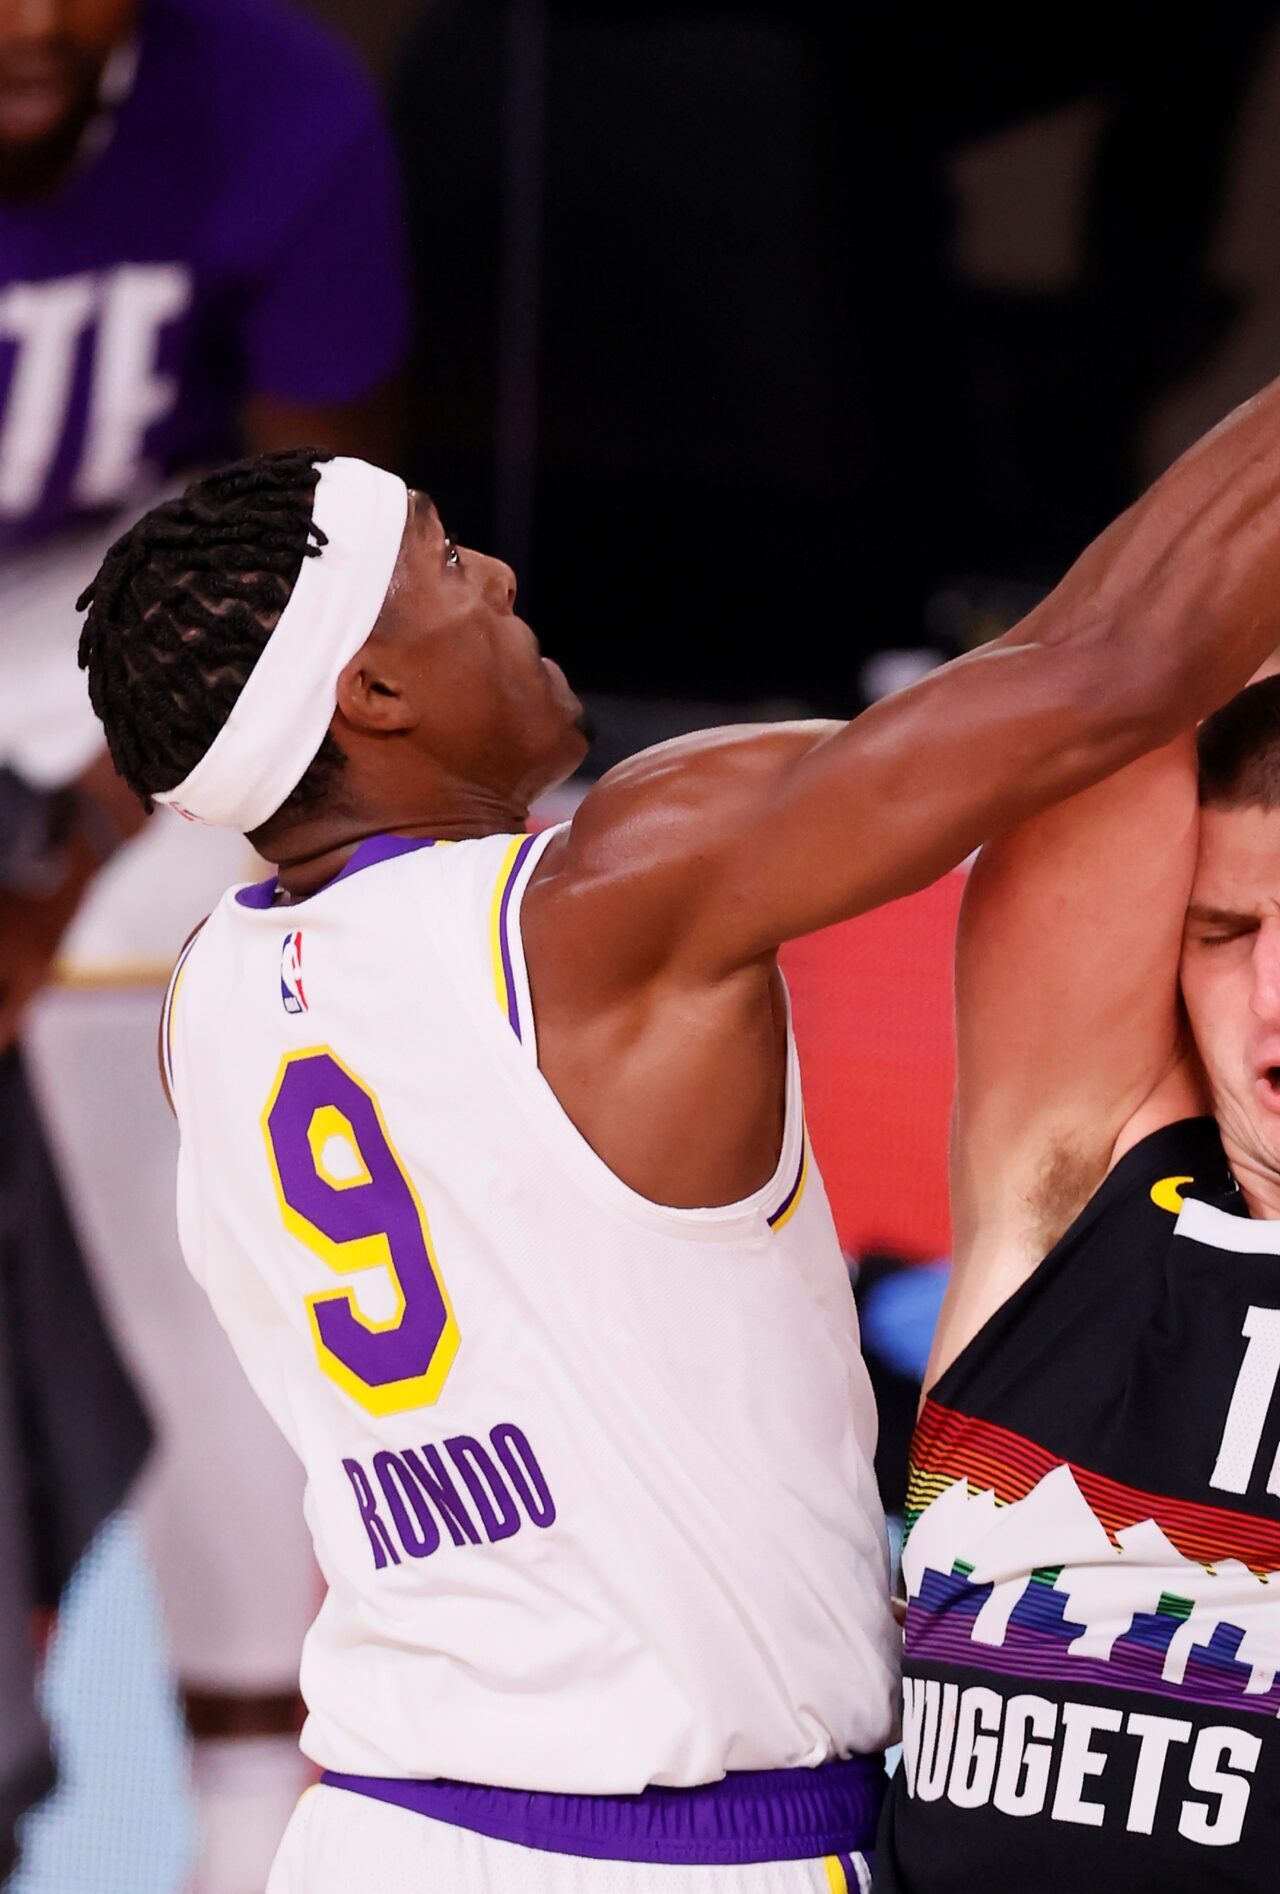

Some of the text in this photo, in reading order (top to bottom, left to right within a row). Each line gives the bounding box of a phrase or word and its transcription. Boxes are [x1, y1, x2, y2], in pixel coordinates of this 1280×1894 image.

[261, 1045, 461, 1418] 9
[342, 1422, 557, 1569] RONDO
[902, 1676, 1263, 1846] NUGGETS
